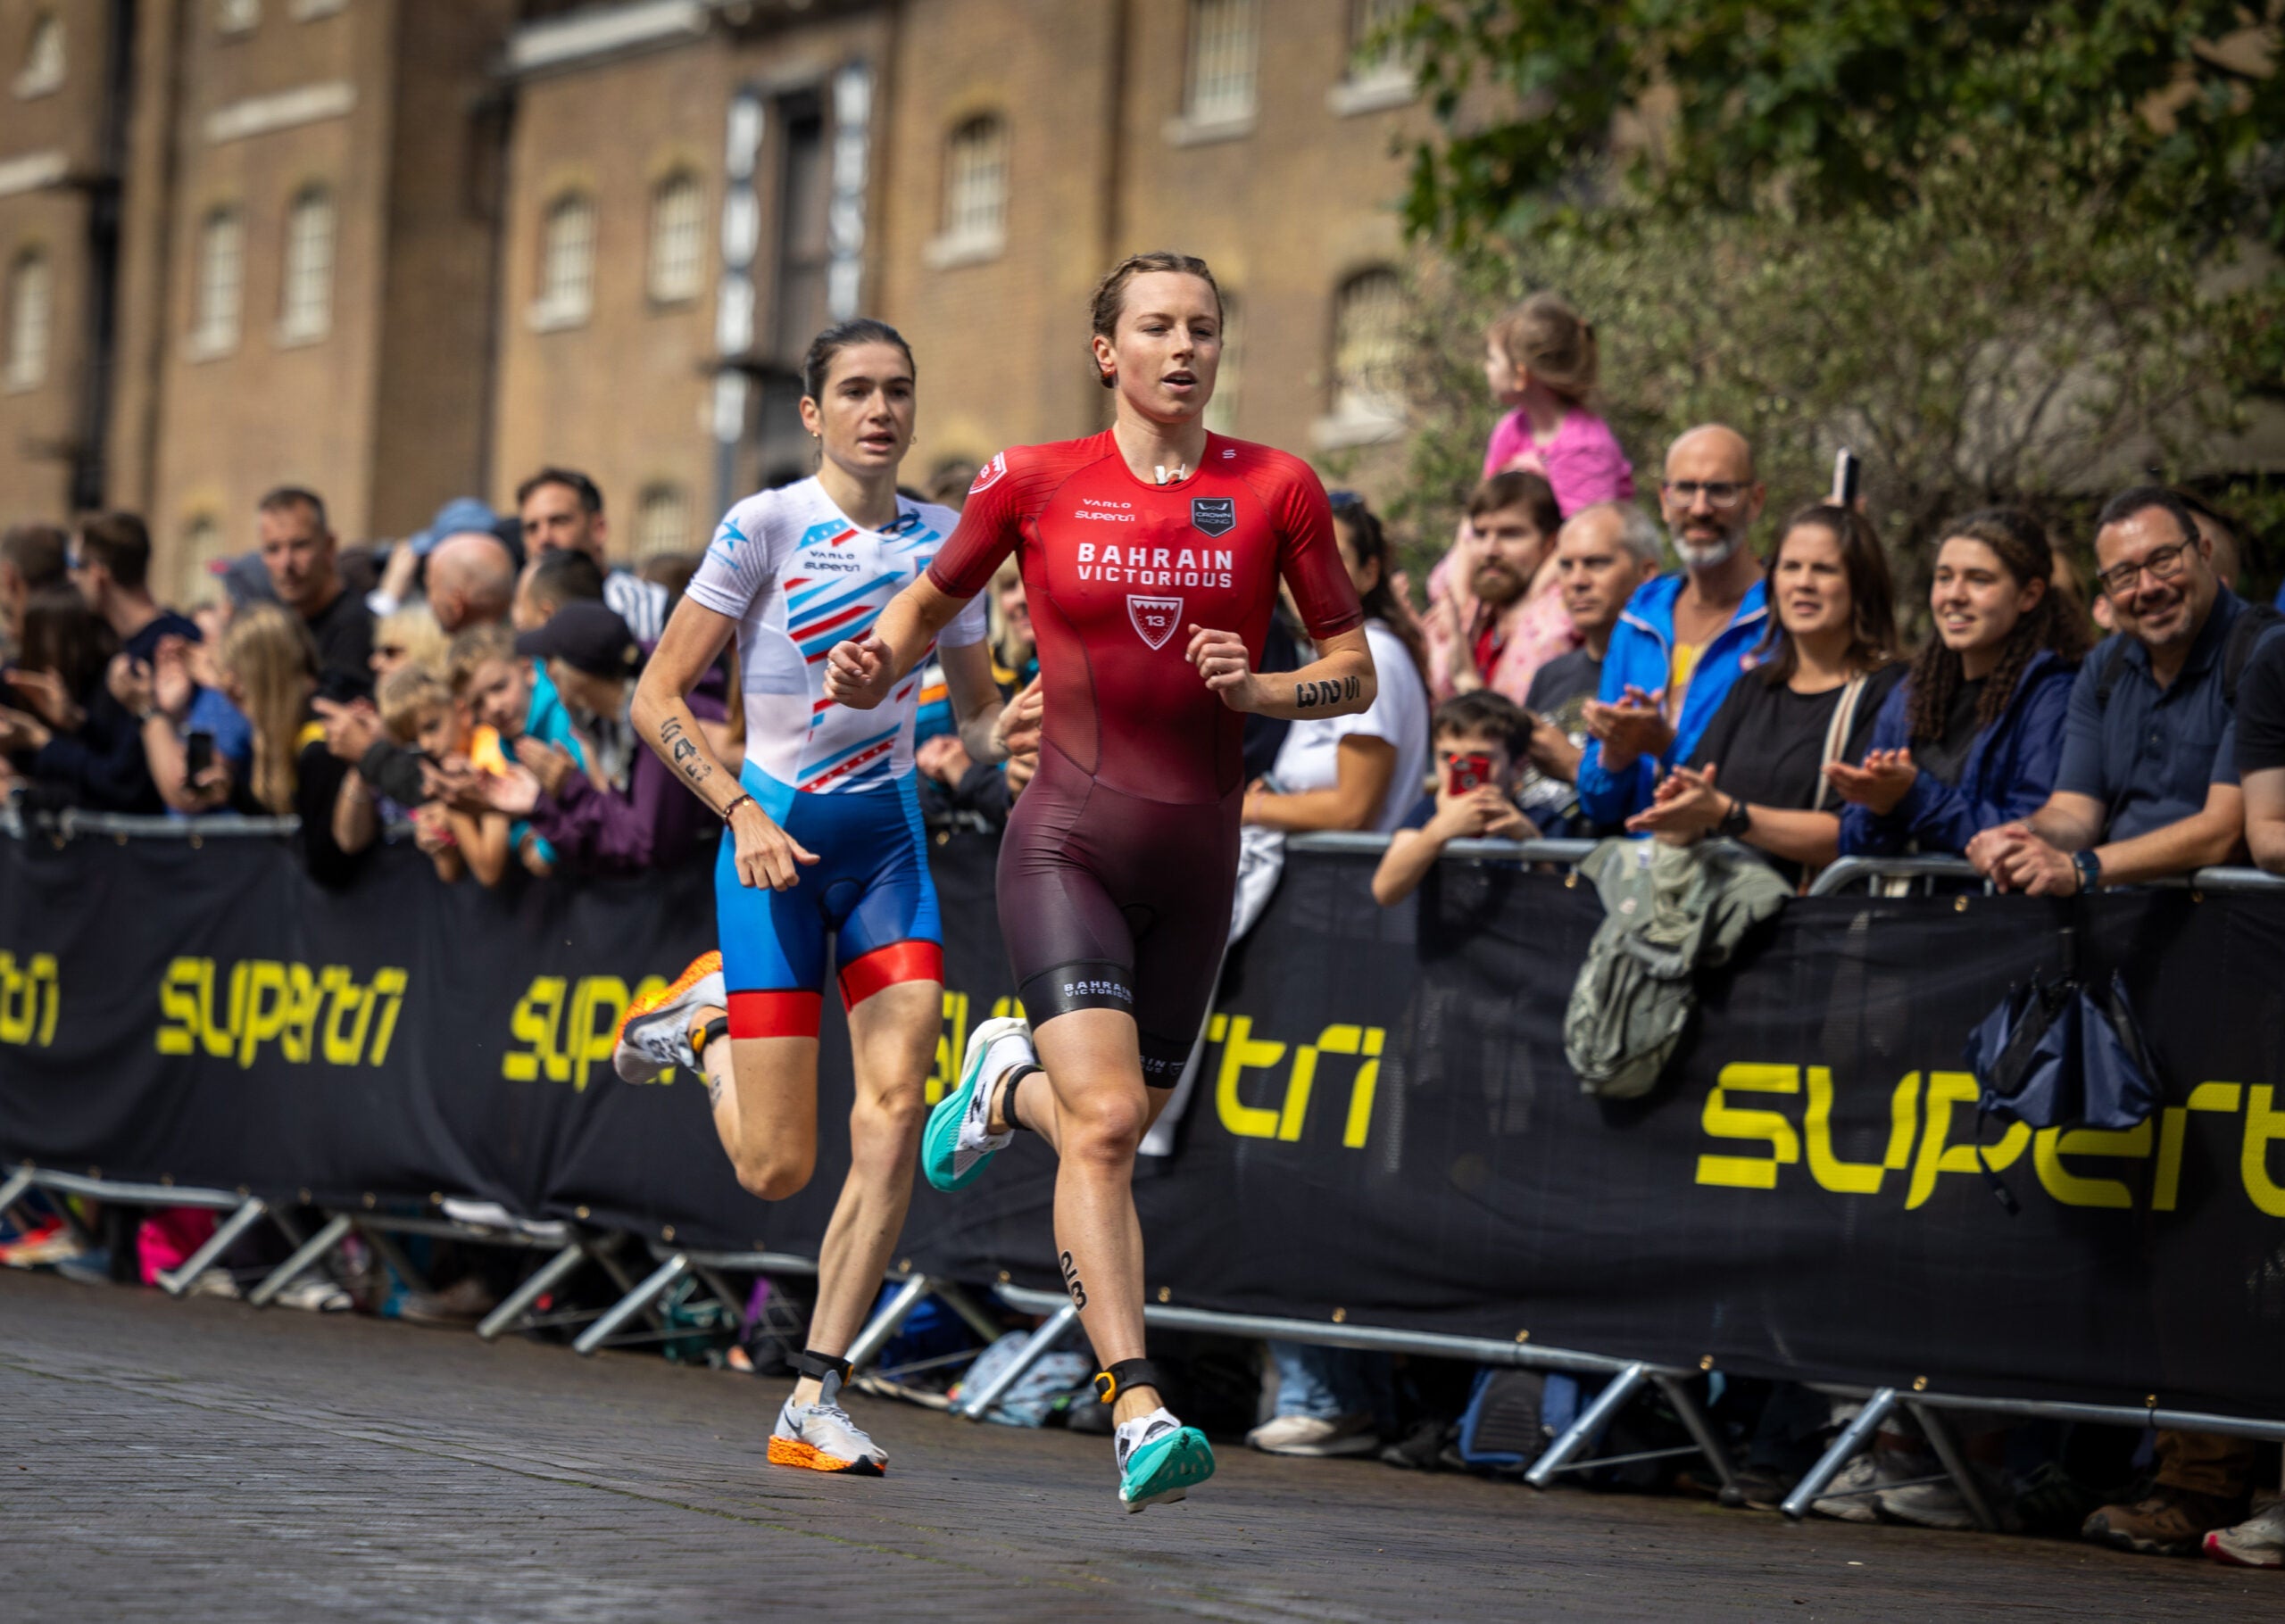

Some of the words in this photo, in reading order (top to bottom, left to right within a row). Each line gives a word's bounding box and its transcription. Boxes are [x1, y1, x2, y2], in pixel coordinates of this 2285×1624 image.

[1082, 498, 1132, 509] VARLO
[810, 551, 855, 559] VARLO
[1077, 543, 1233, 570] BAHRAIN
[1077, 565, 1233, 589] VICTORIOUS
[1145, 615, 1166, 626] 13
[1061, 1250, 1087, 1312] 23
